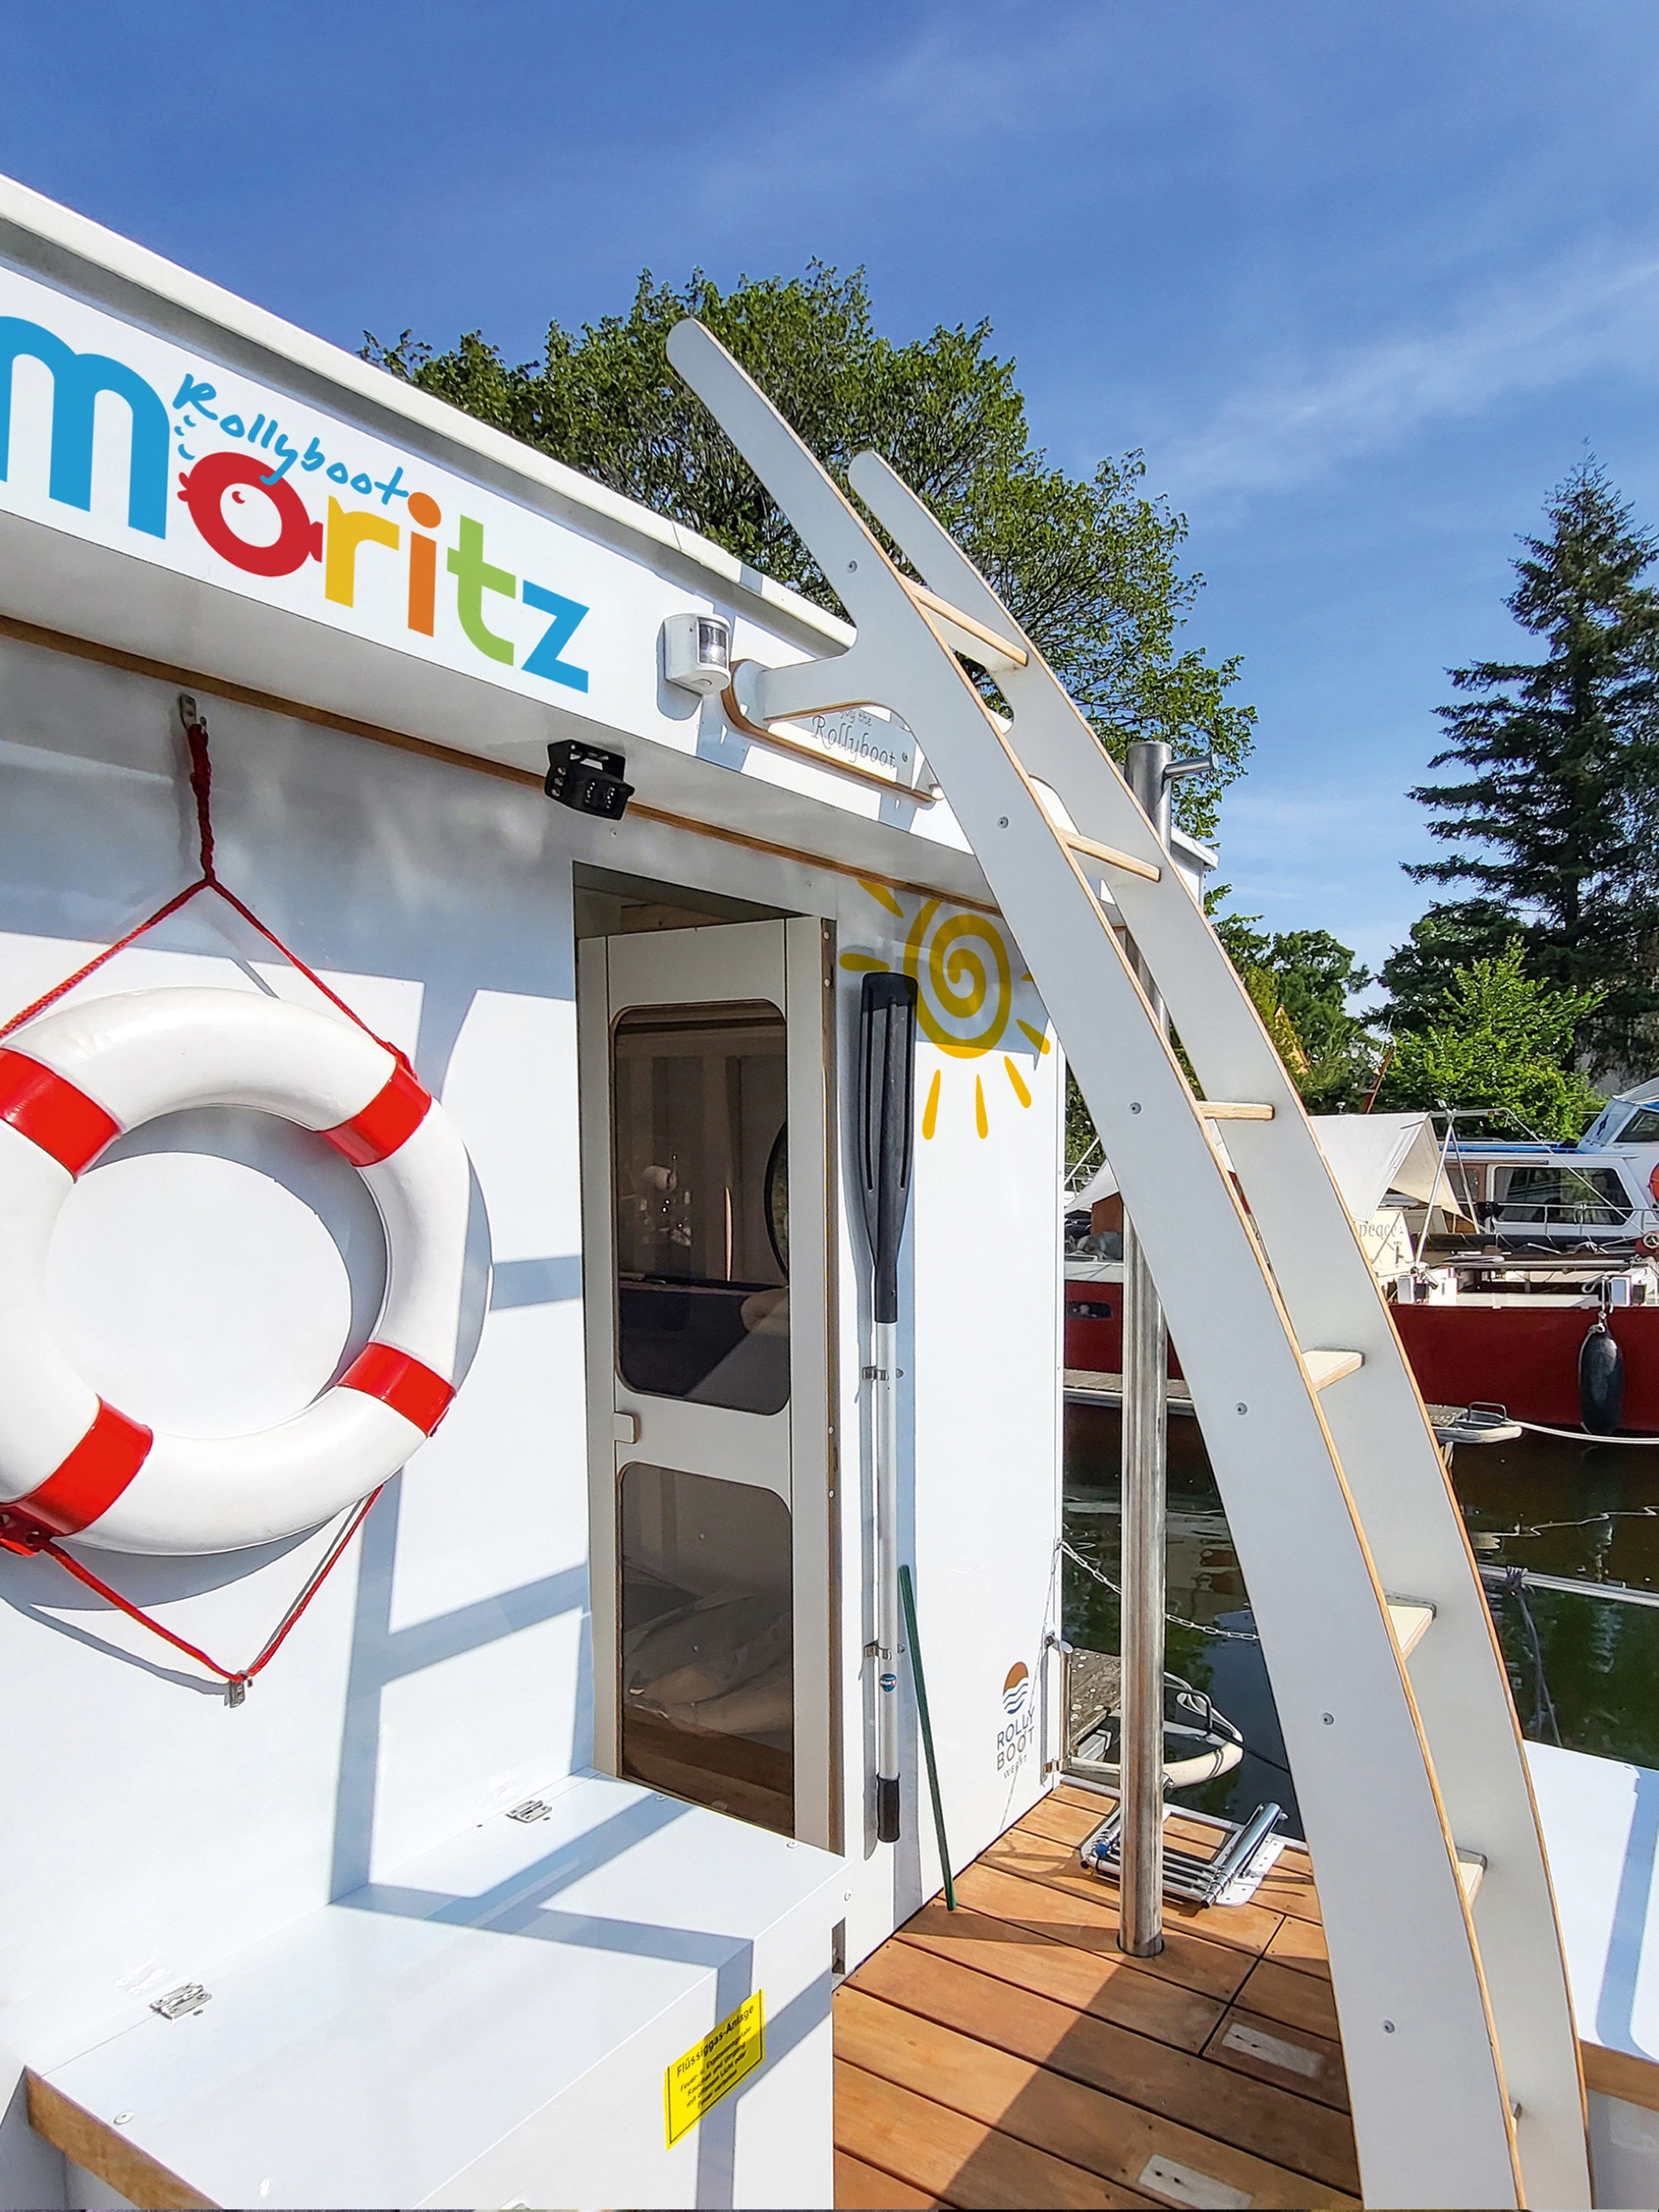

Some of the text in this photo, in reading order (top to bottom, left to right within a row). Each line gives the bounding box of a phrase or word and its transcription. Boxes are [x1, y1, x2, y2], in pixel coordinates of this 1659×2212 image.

[172, 373, 410, 505] Rollyboot
[0, 316, 590, 694] moritz
[996, 1706, 1035, 1751] ROLLY
[996, 1725, 1035, 1771] BOOT
[676, 2005, 755, 2078] Flüssiggas-Anlage
